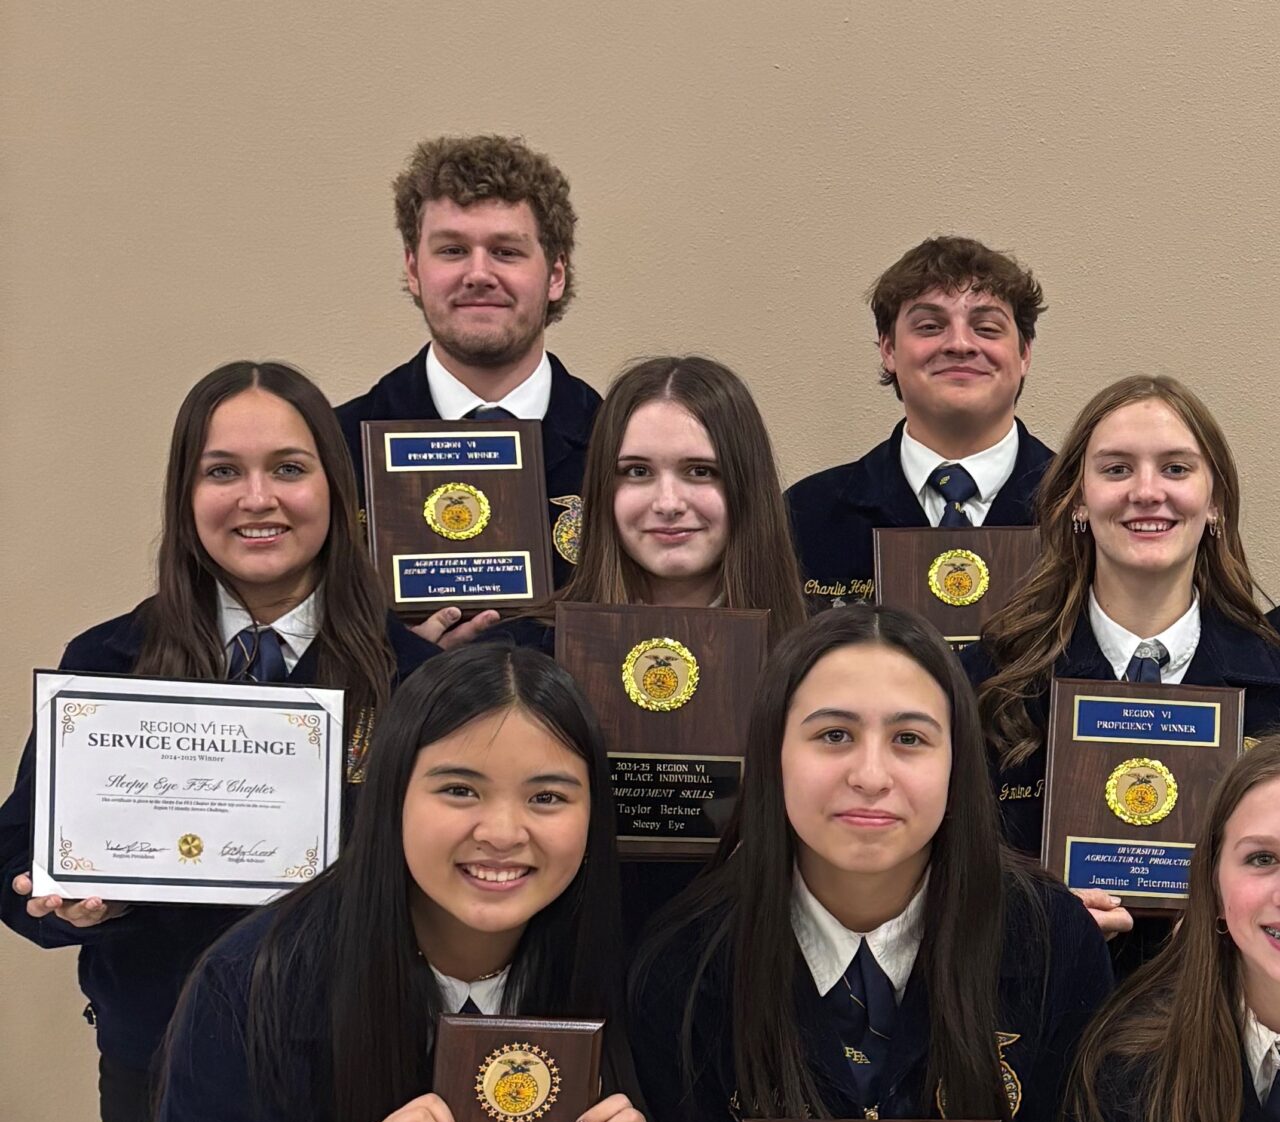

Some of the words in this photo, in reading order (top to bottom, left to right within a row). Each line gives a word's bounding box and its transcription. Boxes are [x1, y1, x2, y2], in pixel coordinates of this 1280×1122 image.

[804, 579, 846, 595] Charlie
[1123, 709, 1155, 718] REGION
[1162, 711, 1171, 719] VI
[140, 721, 196, 734] REGION
[201, 723, 215, 735] VI
[221, 725, 248, 738] FFA
[1097, 721, 1153, 730] PROFICIENCY
[1160, 724, 1196, 733] WINNER
[88, 733, 171, 750] SERVICE
[176, 737, 296, 755] CHALLENGE
[616, 762, 650, 771] 2024-25
[657, 764, 688, 772] REGION
[625, 773, 653, 781] PLACE
[660, 774, 712, 783] INDIVIDUAL
[105, 774, 148, 794] Sleepy
[153, 777, 178, 795] Eye
[182, 778, 221, 791] FFA
[226, 779, 275, 798] Chapter
[611, 788, 675, 798] MPLOYMENT
[680, 790, 715, 798] SKILLS
[617, 804, 651, 815] Taylor
[660, 804, 700, 815] Berkner
[633, 820, 660, 829] Sleepy
[668, 821, 685, 830] Eye
[1117, 847, 1165, 855] DIVERSIFIED
[1085, 855, 1144, 863] AGRICULTURAL
[1149, 858, 1191, 866] PRODUCTIO
[1089, 875, 1129, 886] Jasmine
[1137, 877, 1189, 889] Petermann
